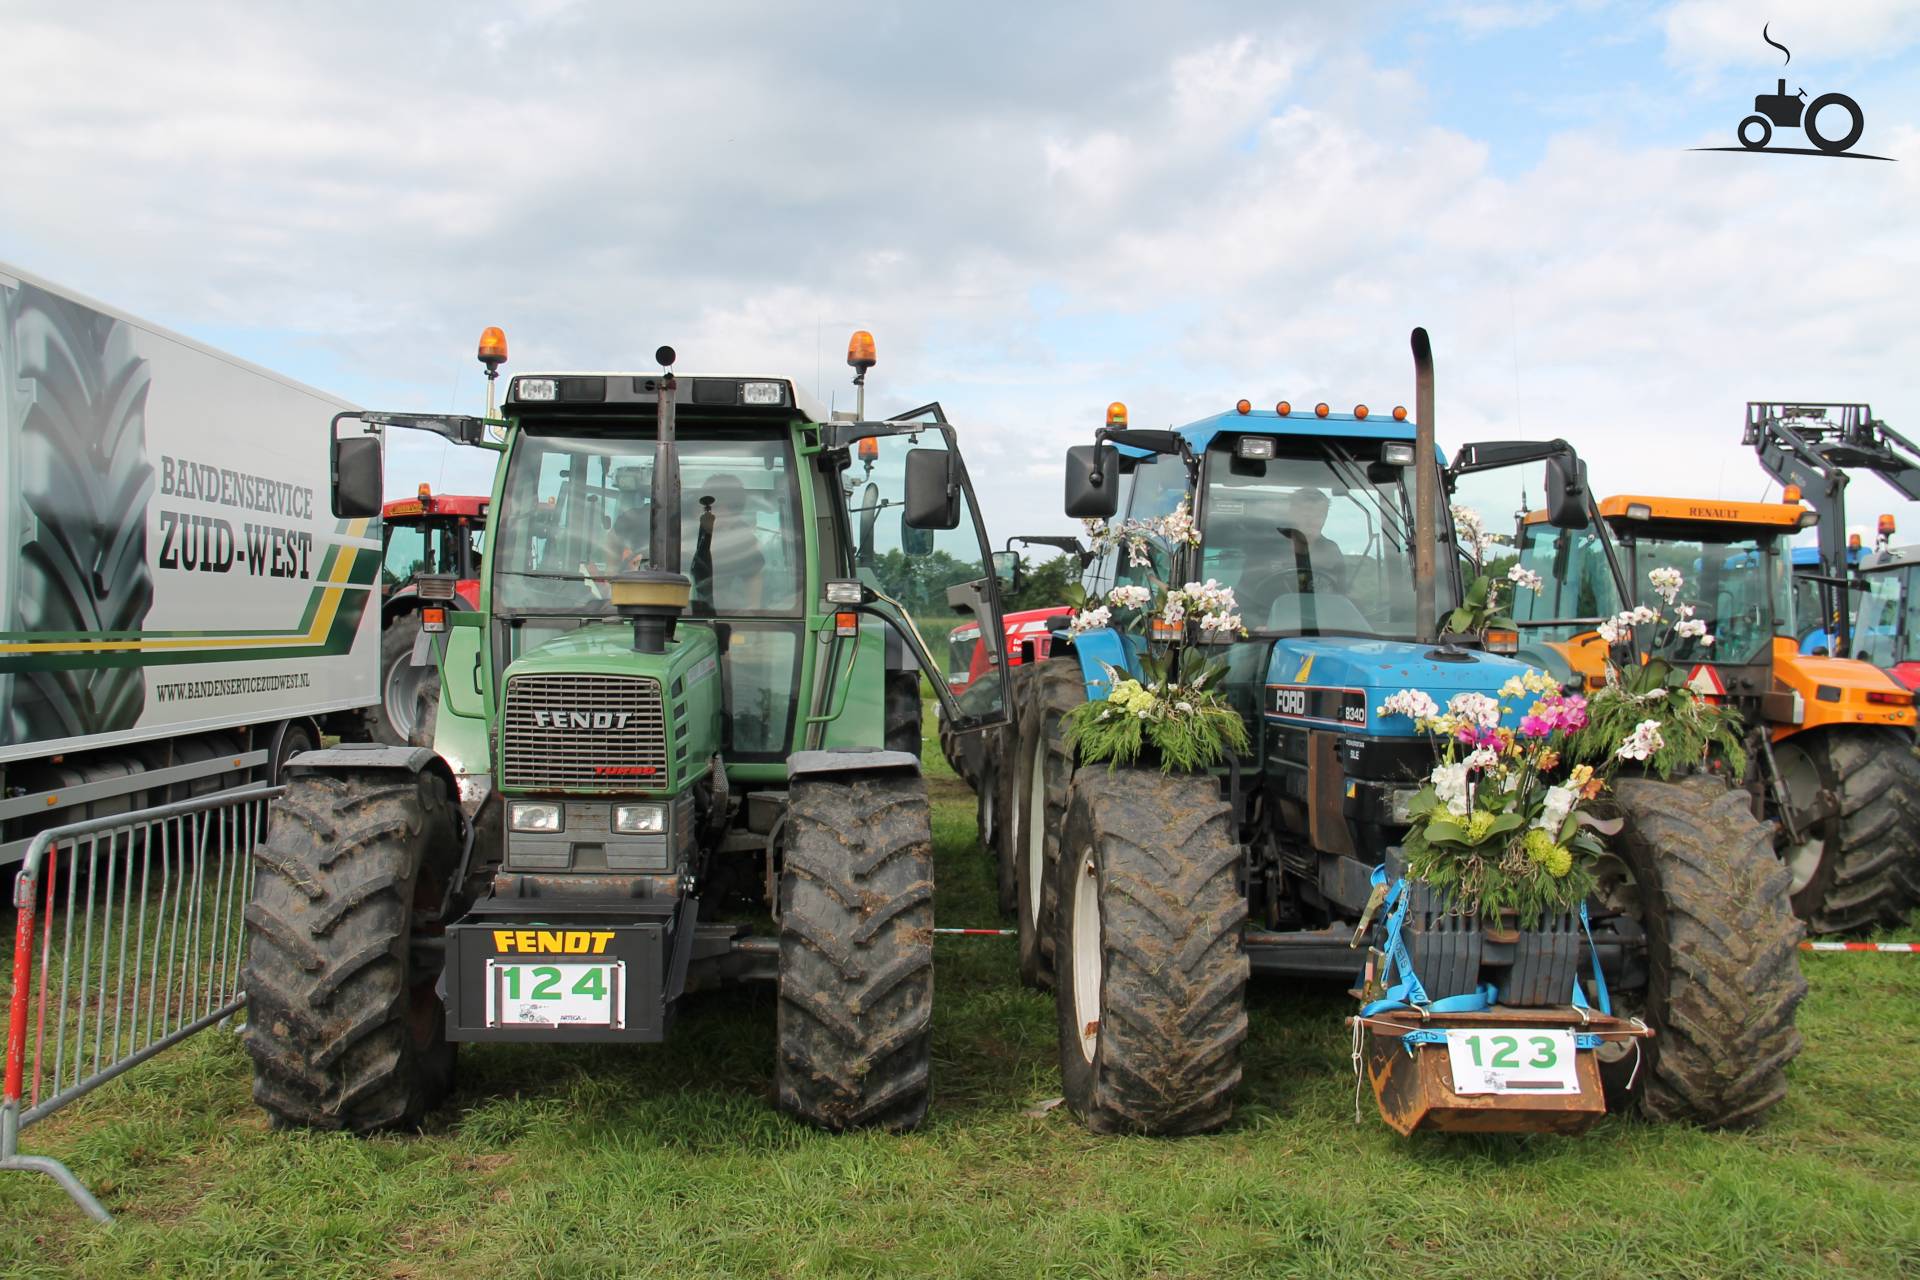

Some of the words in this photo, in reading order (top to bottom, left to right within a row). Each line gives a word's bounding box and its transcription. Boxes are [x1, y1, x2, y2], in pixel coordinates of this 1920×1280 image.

[161, 455, 313, 520] BANDENSERVICE
[1688, 507, 1739, 519] RENAULT
[159, 510, 313, 580] ZUID-WEST
[156, 672, 310, 703] WWW.BANDENSERVICEZUIDWEST.NL
[1276, 689, 1305, 715] FORD
[1345, 706, 1365, 722] 8340
[534, 711, 634, 729] FENDT
[493, 930, 616, 954] FENDT
[503, 966, 608, 1001] 124
[1464, 1035, 1558, 1069] 123
